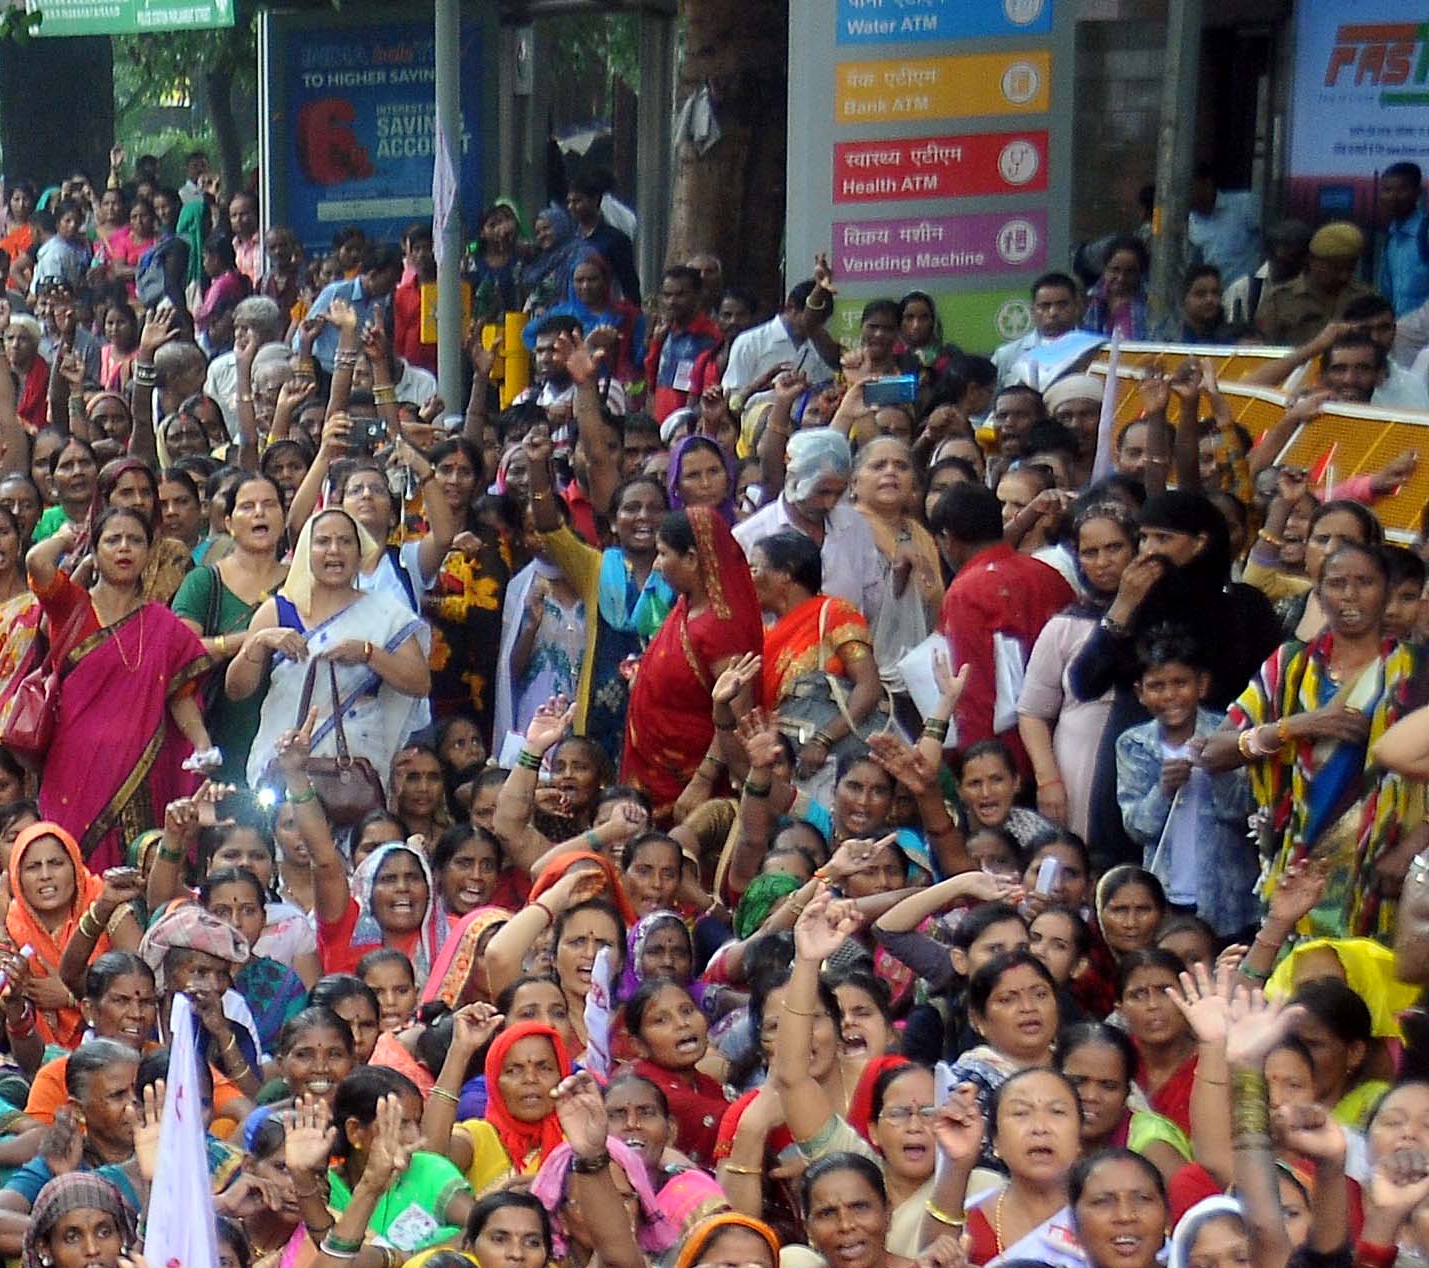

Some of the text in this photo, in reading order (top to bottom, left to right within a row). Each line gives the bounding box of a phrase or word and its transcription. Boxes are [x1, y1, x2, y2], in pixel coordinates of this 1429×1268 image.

[847, 16, 938, 34] Water ATM
[328, 70, 385, 86] HIGHER
[390, 67, 437, 82] SAVIN
[844, 96, 929, 115] Bank ATM
[377, 132, 472, 158] ACCOT
[910, 144, 962, 165] एटीएम
[843, 175, 938, 195] Health ATM
[899, 222, 944, 243] मशीन
[843, 250, 984, 272] Vending Machine
